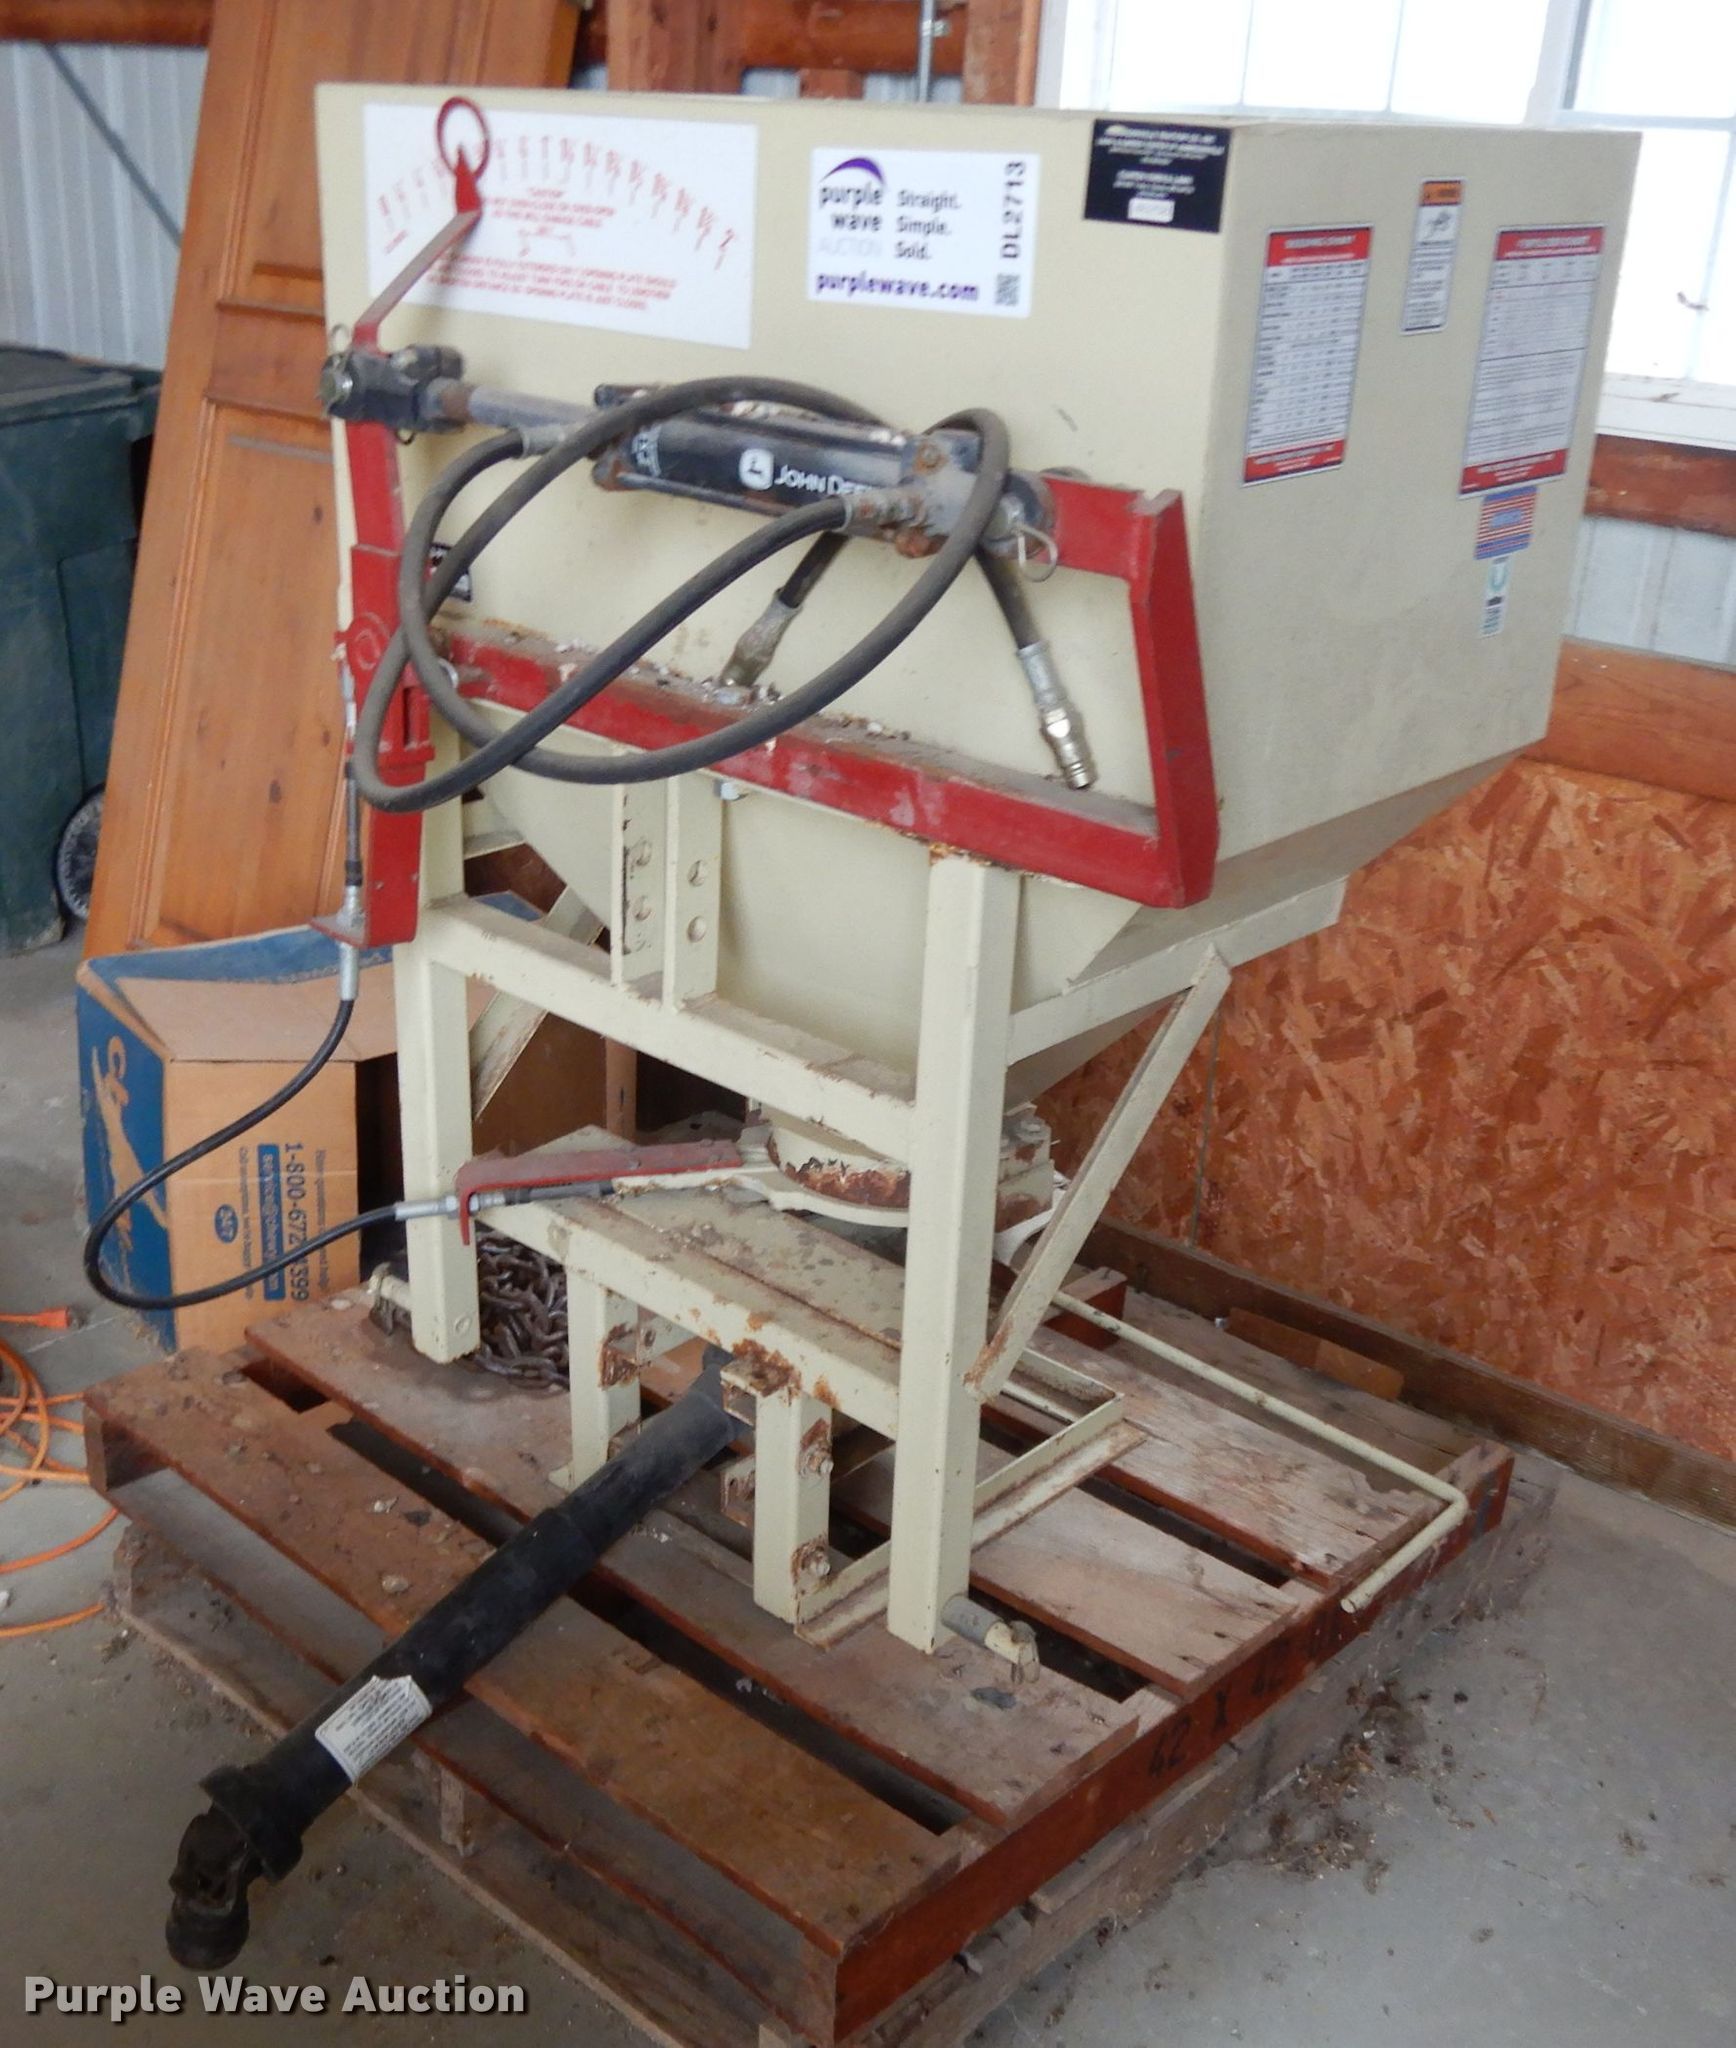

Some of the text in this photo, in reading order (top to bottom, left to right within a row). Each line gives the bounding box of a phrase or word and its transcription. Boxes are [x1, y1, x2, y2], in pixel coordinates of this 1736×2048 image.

[819, 182, 883, 209] purple
[897, 189, 961, 213] Straight.
[831, 213, 882, 231] wave
[1001, 160, 1026, 259] DL2713
[897, 215, 951, 236] Simple.
[896, 241, 932, 259] Sold.
[816, 270, 979, 301] purplewave.com
[774, 464, 826, 492] JOHN
[285, 1142, 310, 1301] 1-800-672399
